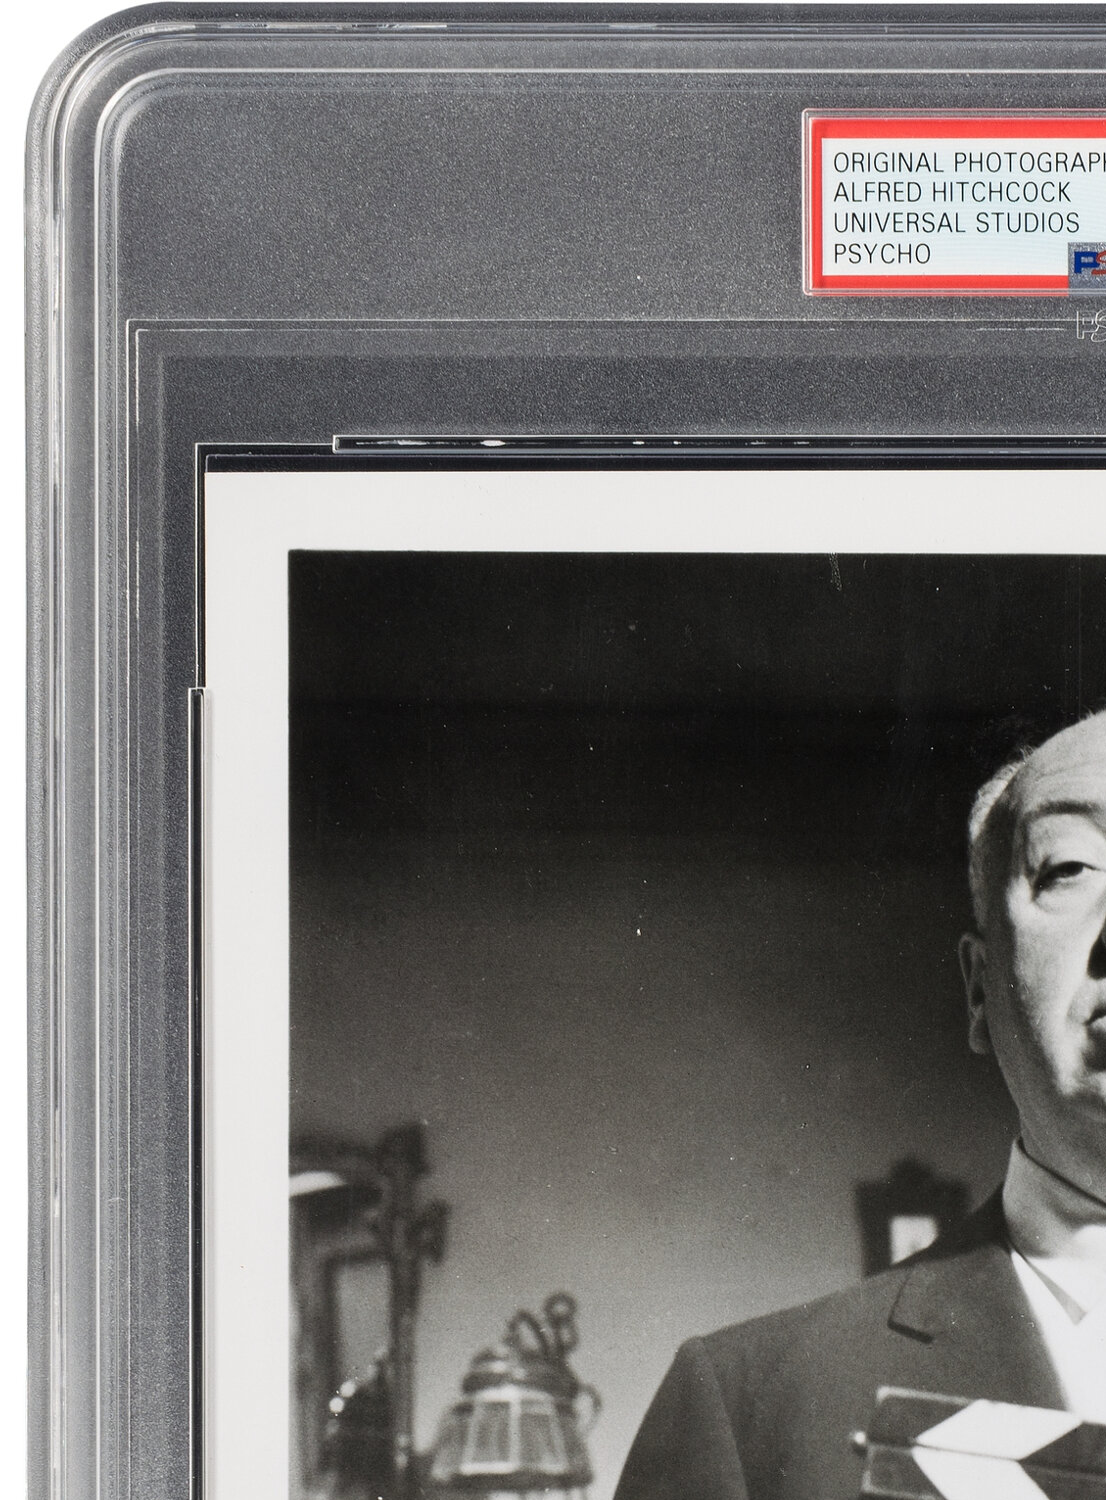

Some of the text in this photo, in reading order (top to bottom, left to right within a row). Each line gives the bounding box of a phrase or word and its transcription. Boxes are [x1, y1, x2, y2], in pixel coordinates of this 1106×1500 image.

[833, 151, 945, 174] ORIGINAL
[833, 181, 1072, 204] ALFRED HITCHCOCK
[833, 211, 1080, 234] UNIVERSAL STUDIOS
[833, 243, 931, 265] PSYCHO
